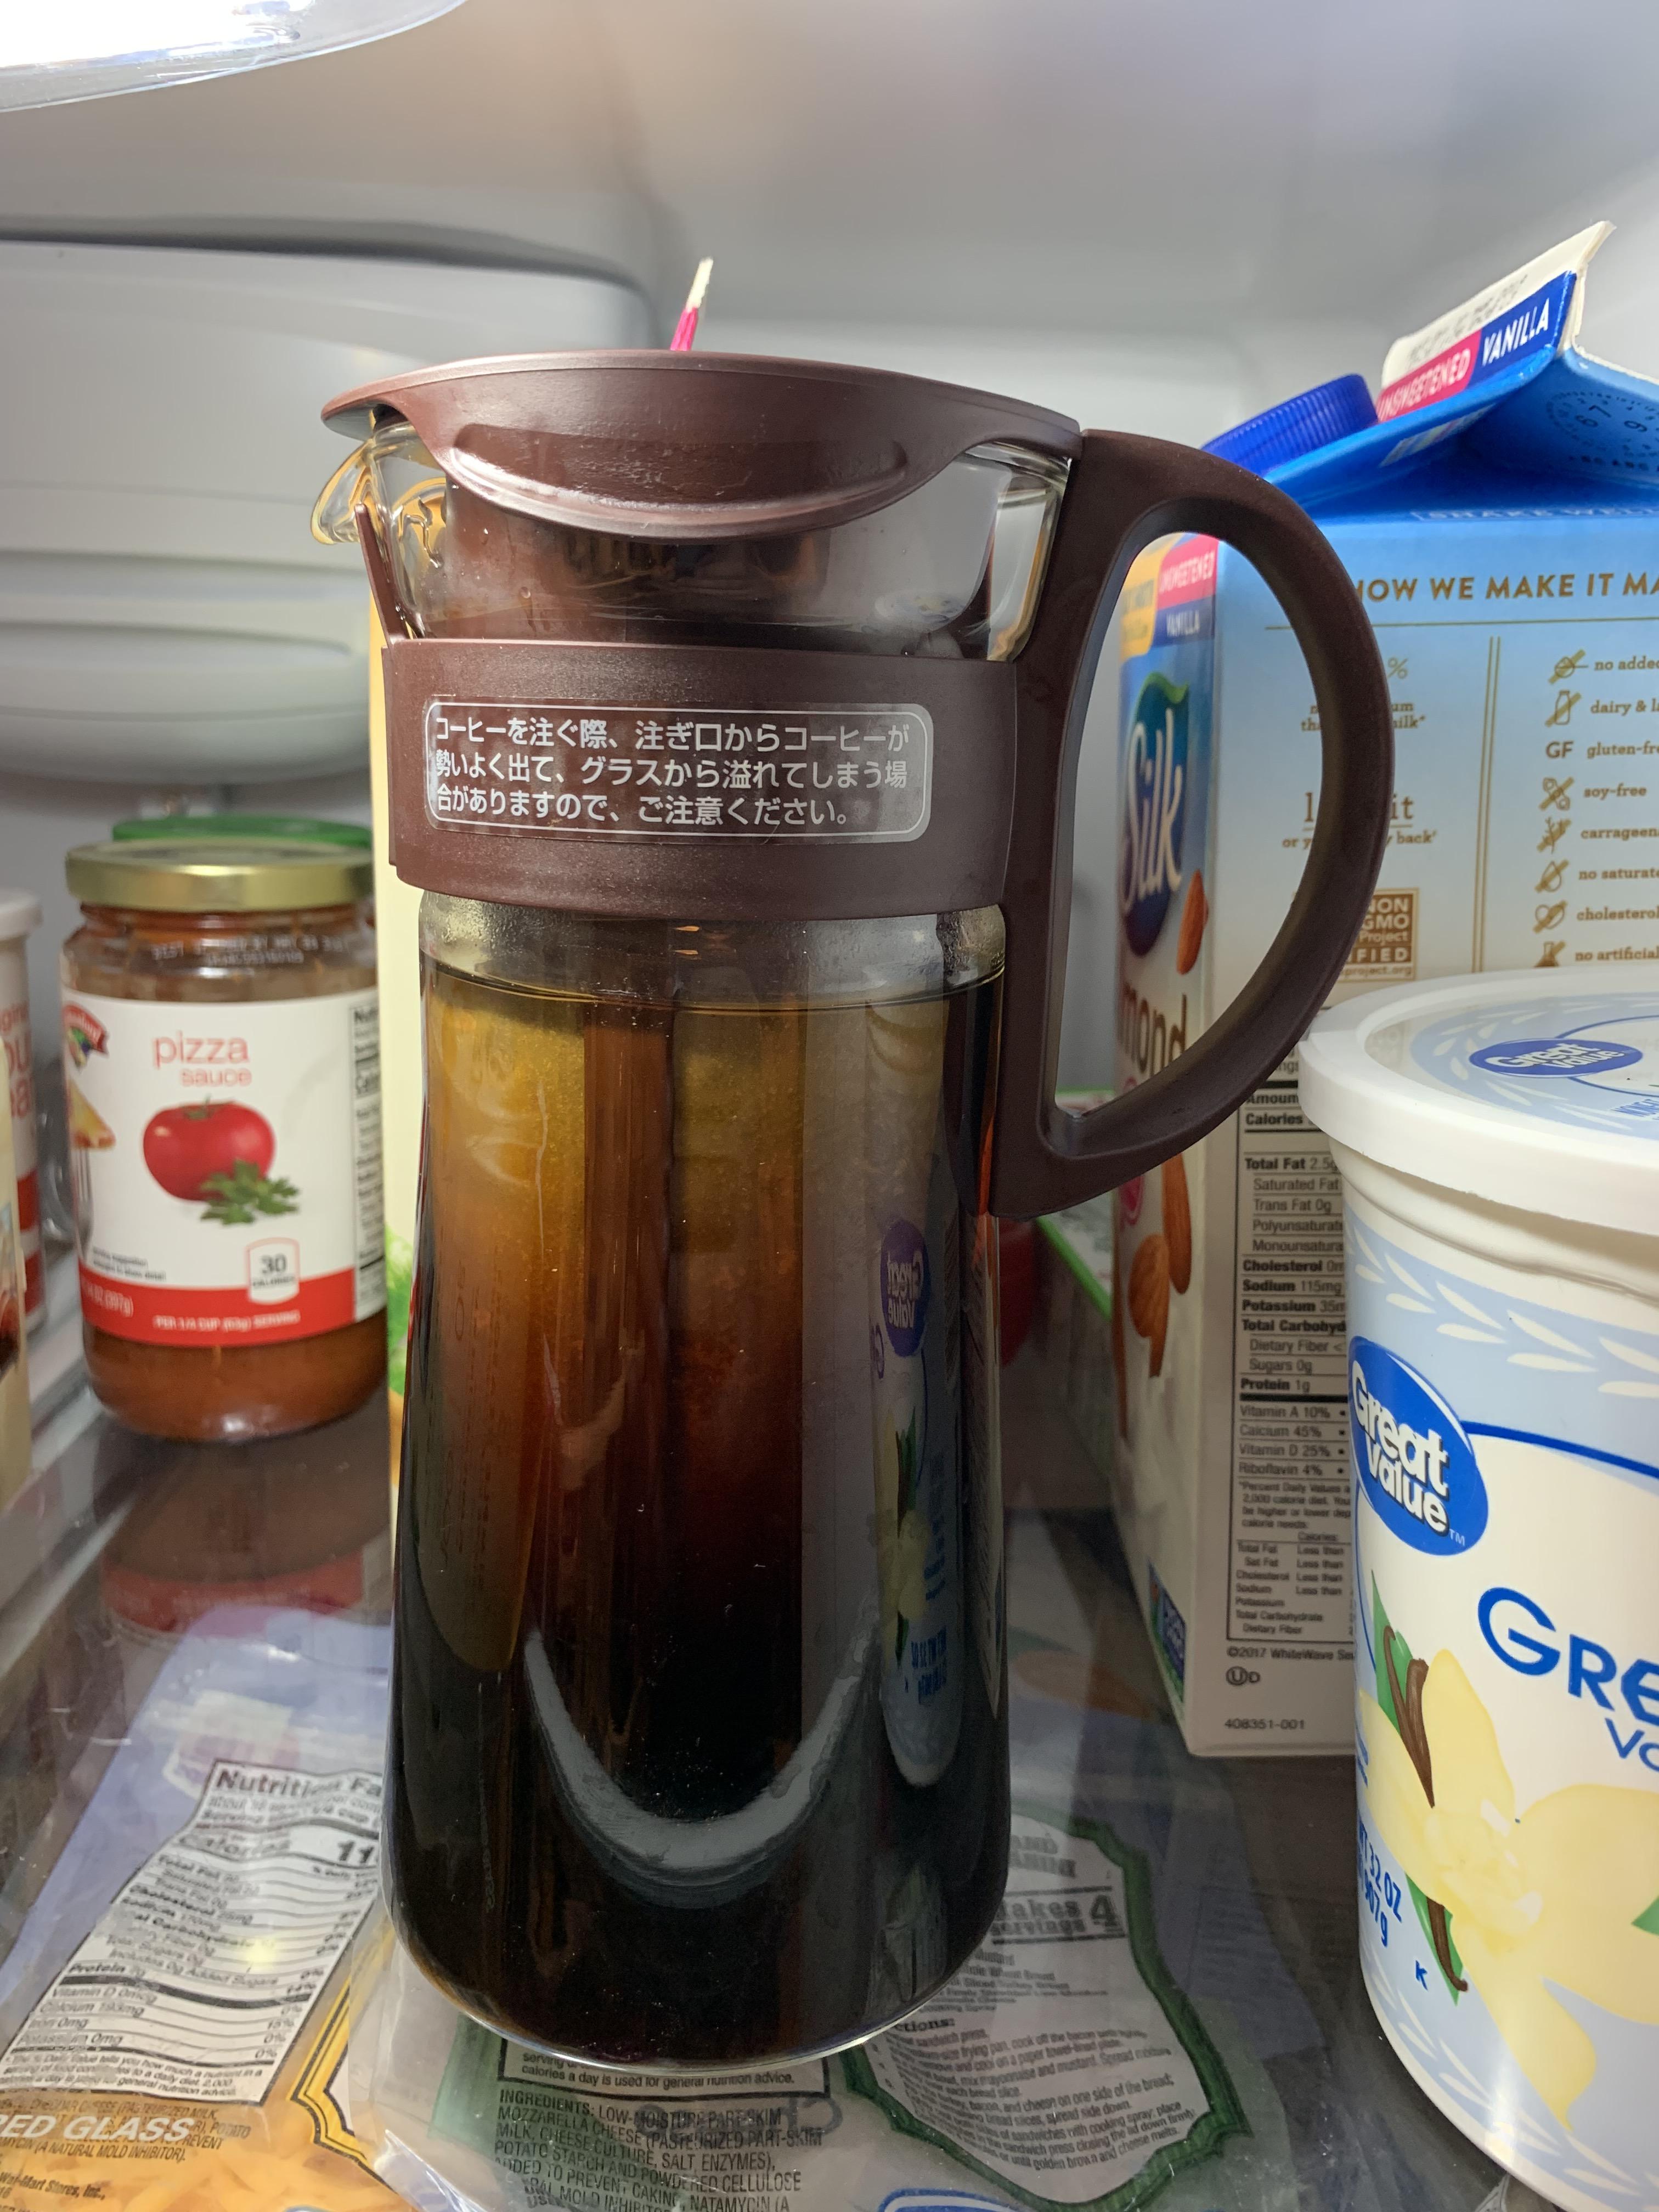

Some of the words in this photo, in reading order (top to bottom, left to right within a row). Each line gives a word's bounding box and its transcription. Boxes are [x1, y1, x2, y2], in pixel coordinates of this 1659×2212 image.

[1483, 298, 1549, 366] VANILLA
[1430, 577, 1475, 600] WE
[1486, 574, 1575, 599] MAKE
[1586, 573, 1614, 596] IT
[1594, 661, 1613, 670] no
[1590, 699, 1632, 716] dairy
[1636, 700, 1646, 712] &
[435, 716, 909, 752] コーヒーを注ぐ際、注ぎ口からコーヒーが
[1546, 741, 1574, 759] GF
[1584, 783, 1647, 800] soy-free
[436, 784, 847, 826] 合がありますので、ご注意ください。
[1120, 708, 1182, 917] Silk
[1581, 828, 1659, 840] carrageen
[1579, 870, 1597, 880] no
[1363, 913, 1409, 930] GMO
[1359, 932, 1408, 946] Project
[1575, 951, 1593, 961] no
[153, 1030, 250, 1069] pizza
[1484, 1043, 1601, 1067] Great
[182, 1068, 252, 1086] sauce
[1246, 1113, 1303, 1125] Calories
[1245, 1158, 1278, 1169] Total
[1284, 1158, 1305, 1169] Fat
[1254, 1177, 1314, 1190] Saturated
[1319, 1178, 1339, 1190] Fat
[1254, 1198, 1287, 1210] Trans
[1291, 1199, 1311, 1210] Fat
[1316, 1198, 1332, 1214] 0g
[1252, 1239, 1343, 1251] Monounsatura
[259, 1253, 287, 1275] 30
[1243, 1259, 1322, 1271] Cholesterol
[1243, 1279, 1296, 1291] Sodium
[1301, 1280, 1341, 1295] 115mg
[1242, 1299, 1316, 1311] Potassium
[1320, 1300, 1344, 1312] 35m
[1242, 1319, 1274, 1331] Total
[1279, 1319, 1346, 1336] Carbohyd
[1250, 1339, 1292, 1354] Dietary
[1298, 1339, 1329, 1351] Fiber
[1249, 1358, 1292, 1374] Sugars
[1296, 1359, 1312, 1375] 0g
[1241, 1378, 1290, 1390] Protein
[1296, 1379, 1311, 1393] 1g
[1240, 1405, 1286, 1417] Vitamin
[1290, 1406, 1299, 1418] A
[1305, 1407, 1330, 1418] 10%
[1240, 1424, 1289, 1436] Calcium
[1294, 1425, 1322, 1438] 45%
[1351, 1359, 1448, 1498] Great
[1239, 1443, 1285, 1455] Vitamin
[1289, 1444, 1298, 1455] D
[1303, 1444, 1330, 1457] 25%
[1239, 1462, 1299, 1474] Riboflavin
[1303, 1464, 1323, 1476] 4%
[1365, 1442, 1449, 1536] Value
[1448, 1530, 1466, 1547] TM
[1477, 1586, 1659, 1726] GRE
[1370, 1842, 1381, 1892] 32
[1384, 1871, 1402, 1923] OZ
[1416, 1960, 1427, 1990] K
[522, 2064, 565, 2079] calories
[568, 2073, 575, 2081] a
[579, 2072, 599, 2086] day
[602, 2074, 611, 2085] is
[614, 2076, 642, 2086] used
[646, 2076, 659, 2086] for
[663, 2076, 704, 2090] general
[754, 2072, 795, 2084] advice.
[500, 2089, 594, 2117] INGREDIENTS:
[63, 2115, 195, 2142] GLASS
[498, 2106, 589, 2132] MOZZARELLA
[593, 2120, 642, 2146] CHEESE
[747, 2127, 823, 2148] PART-SKIM
[49, 2142, 94, 2157] NATURAL
[96, 2145, 128, 2158] MOLD
[540, 2127, 592, 2151] CHEESE
[594, 2140, 657, 2169] CULTURE,
[702, 2151, 776, 2171] ENZYMES),
[495, 2140, 548, 2158] POTATO
[552, 2146, 605, 2172] STARCH
[608, 2160, 637, 2179] AND
[722, 2172, 802, 2192] CELLULOSE
[0, 2172, 46, 2190] Wal-Mart
[45, 2180, 80, 2198] Stores,
[567, 2169, 627, 2194] PREVENT
